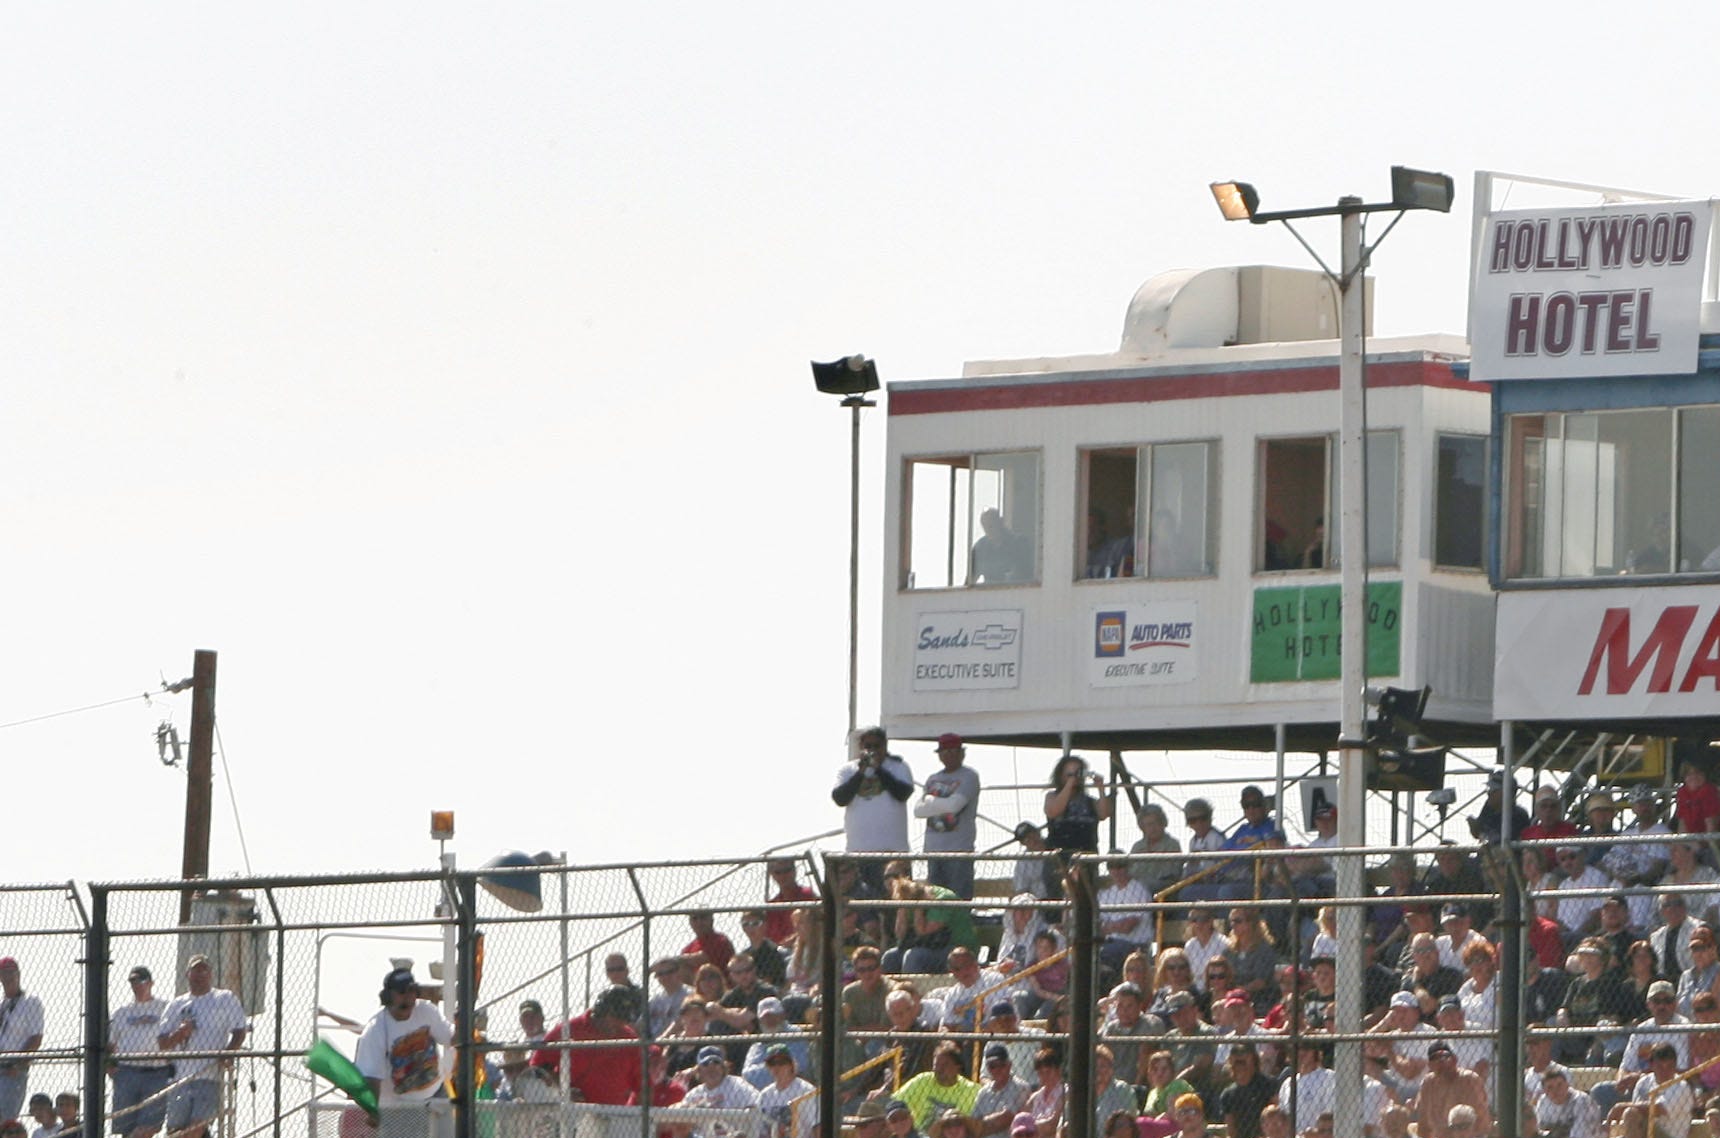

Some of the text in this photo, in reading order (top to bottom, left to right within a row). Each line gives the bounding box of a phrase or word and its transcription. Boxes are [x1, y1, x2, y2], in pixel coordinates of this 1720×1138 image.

[1489, 212, 1696, 273] HOLLYWOOD
[1504, 288, 1661, 357] HOTEL
[918, 626, 970, 649] Sands
[1131, 624, 1159, 641] AUTO
[1161, 622, 1193, 640] PARTS
[916, 662, 1015, 679] EXECUTIVE SUITE
